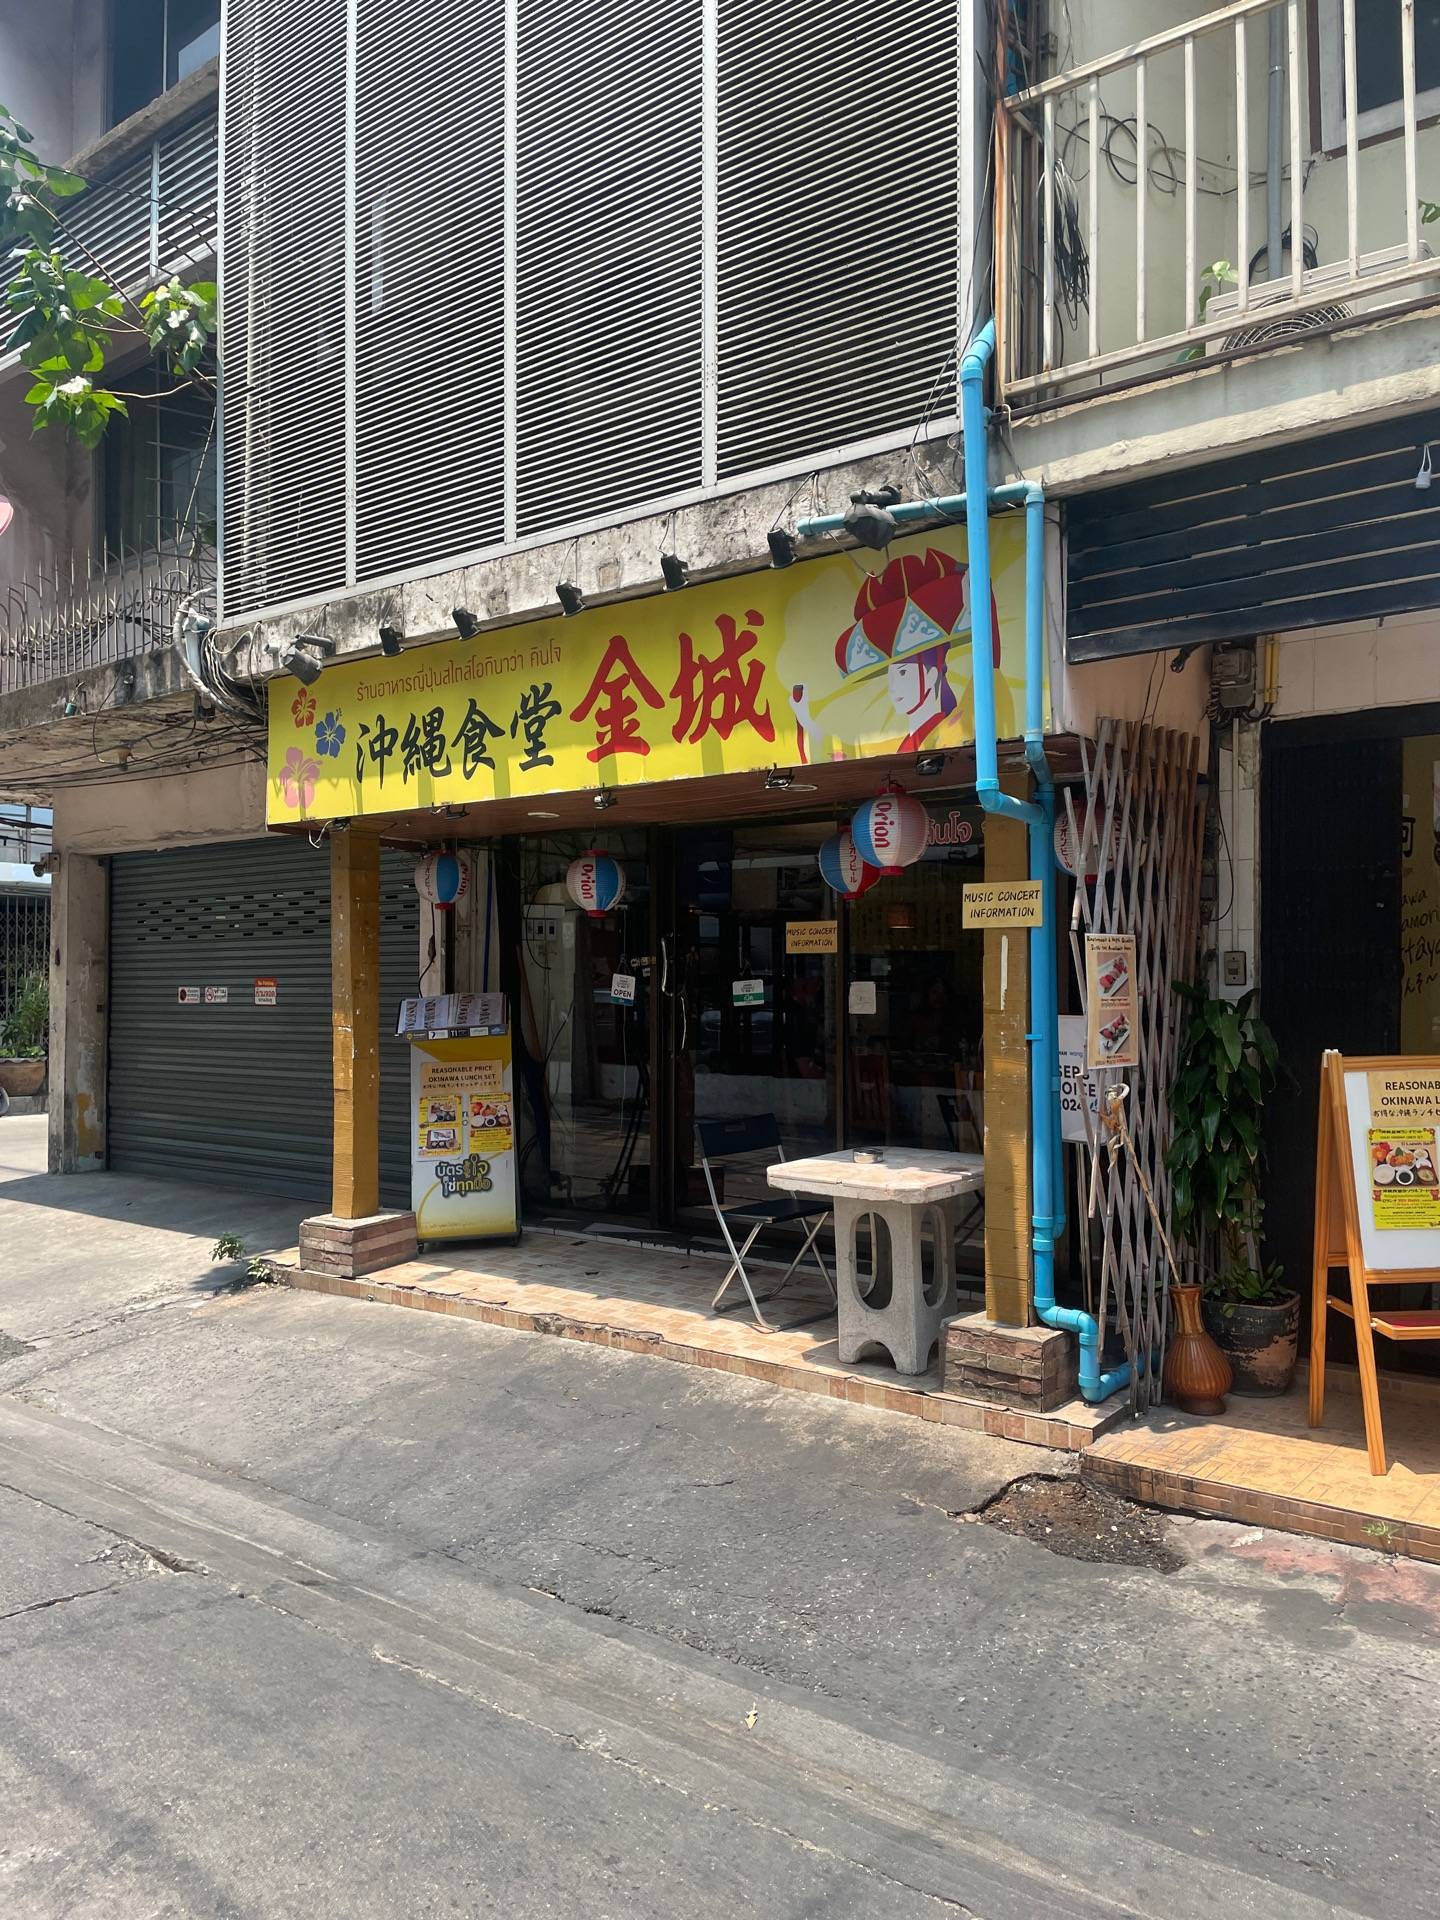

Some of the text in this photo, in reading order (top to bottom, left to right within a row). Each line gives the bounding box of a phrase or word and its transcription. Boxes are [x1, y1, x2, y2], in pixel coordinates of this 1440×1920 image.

[531, 638, 561, 667] คินโจ
[356, 609, 775, 789] 沖縄食堂 金城
[875, 802, 894, 848] Orion
[581, 864, 595, 899] Orion
[964, 890, 1040, 904] MUSIC CONCERT
[970, 907, 1034, 919] INFORMATION
[786, 927, 837, 936] MUSIC CONCERT
[791, 939, 833, 948] INFORMATION
[613, 989, 632, 998] OPEN
[432, 1066, 472, 1074] REASONABLE
[428, 1075, 460, 1083] OKINAWA
[1381, 1096, 1432, 1106] OKINAWA
